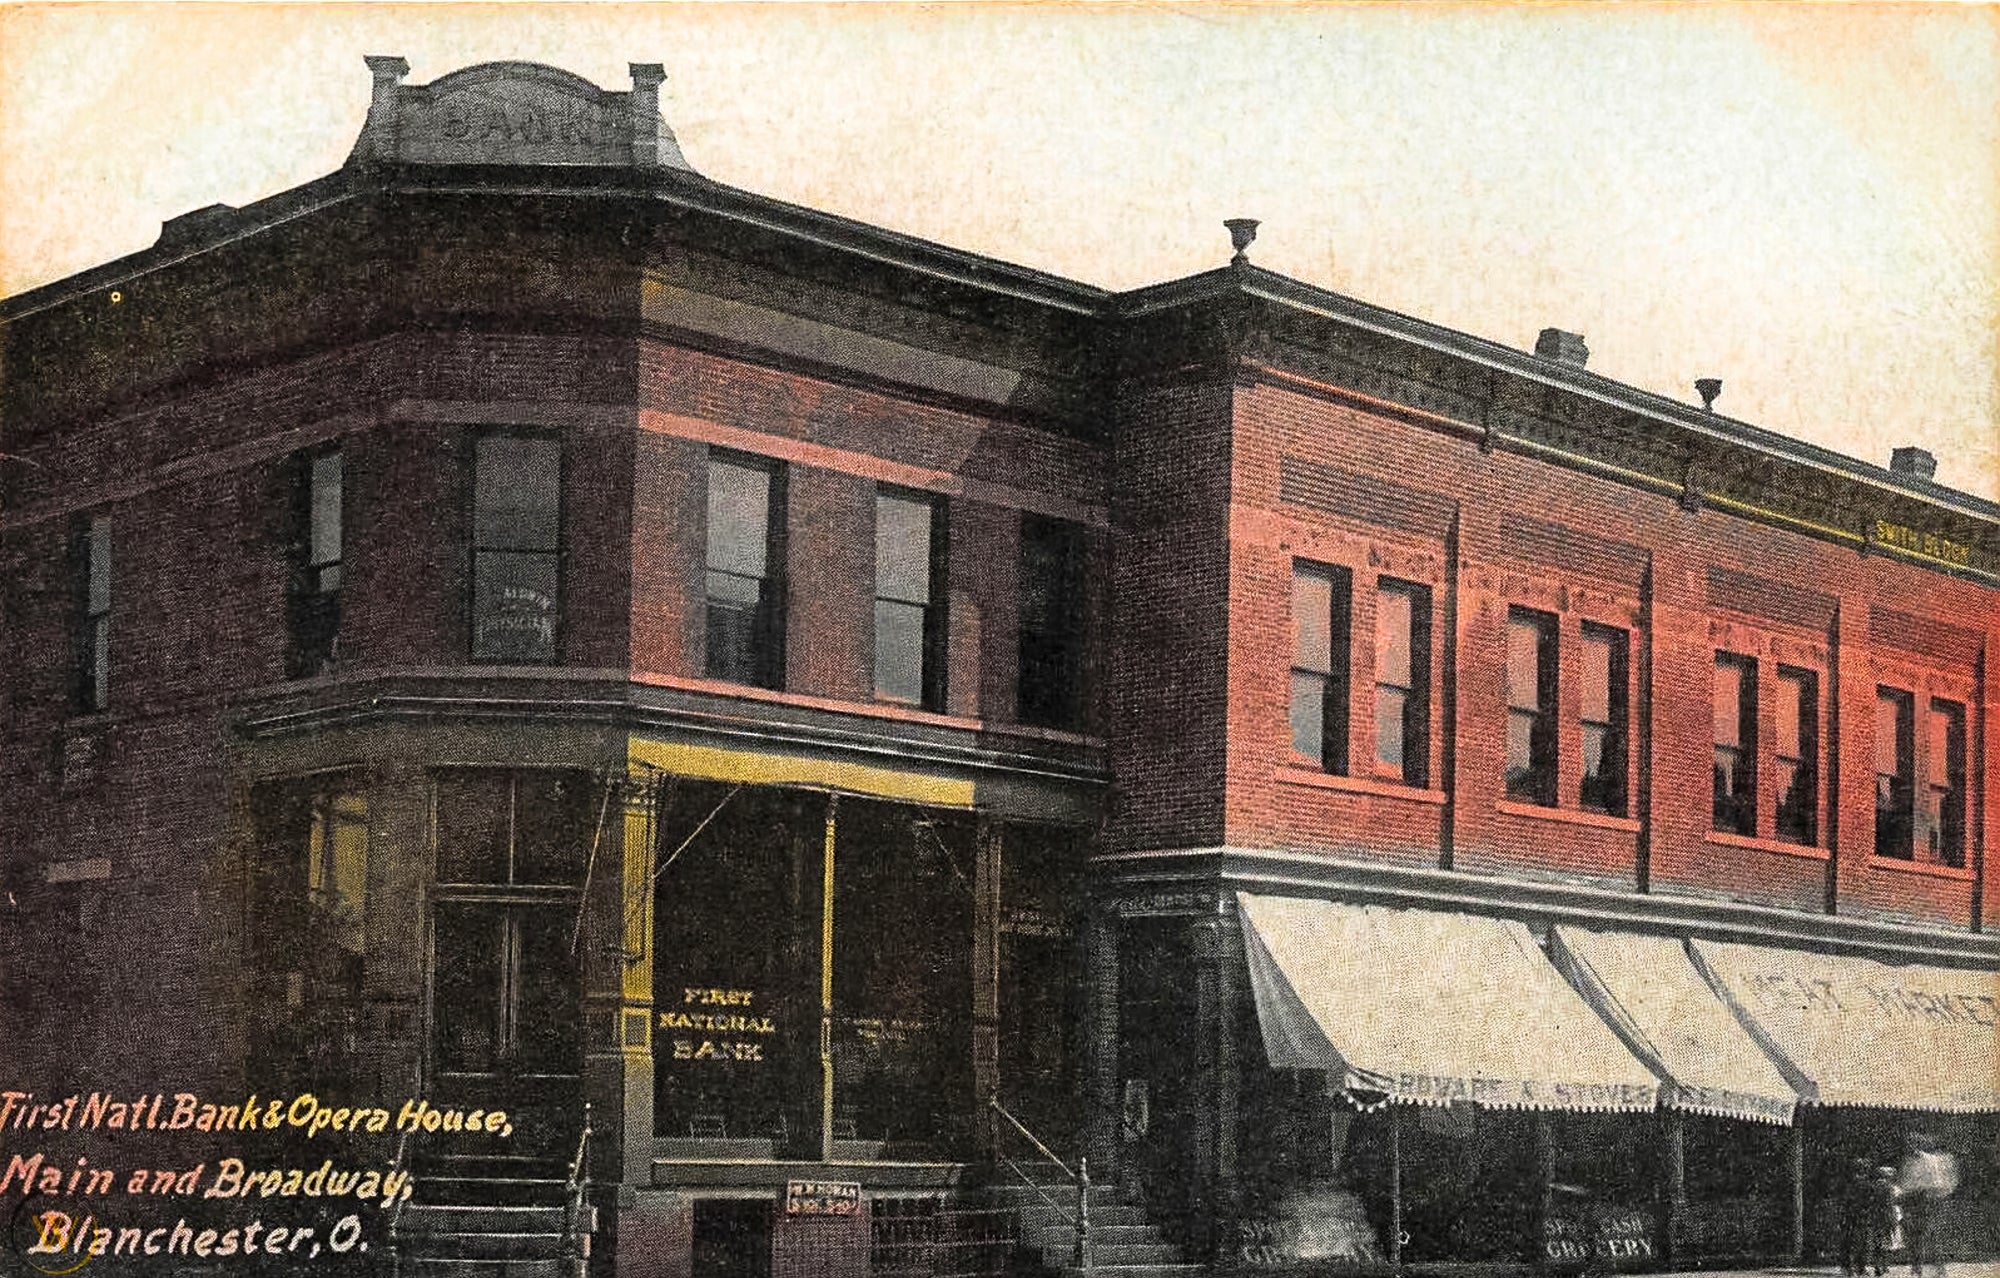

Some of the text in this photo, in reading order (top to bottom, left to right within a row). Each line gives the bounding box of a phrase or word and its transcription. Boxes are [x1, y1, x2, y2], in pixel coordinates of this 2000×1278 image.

[441, 103, 597, 144] BANK
[684, 987, 754, 1006] FIRST
[659, 1011, 775, 1034] NATIONAL
[673, 1039, 763, 1062] BANK
[1546, 1236, 1652, 1259] GROCERY
